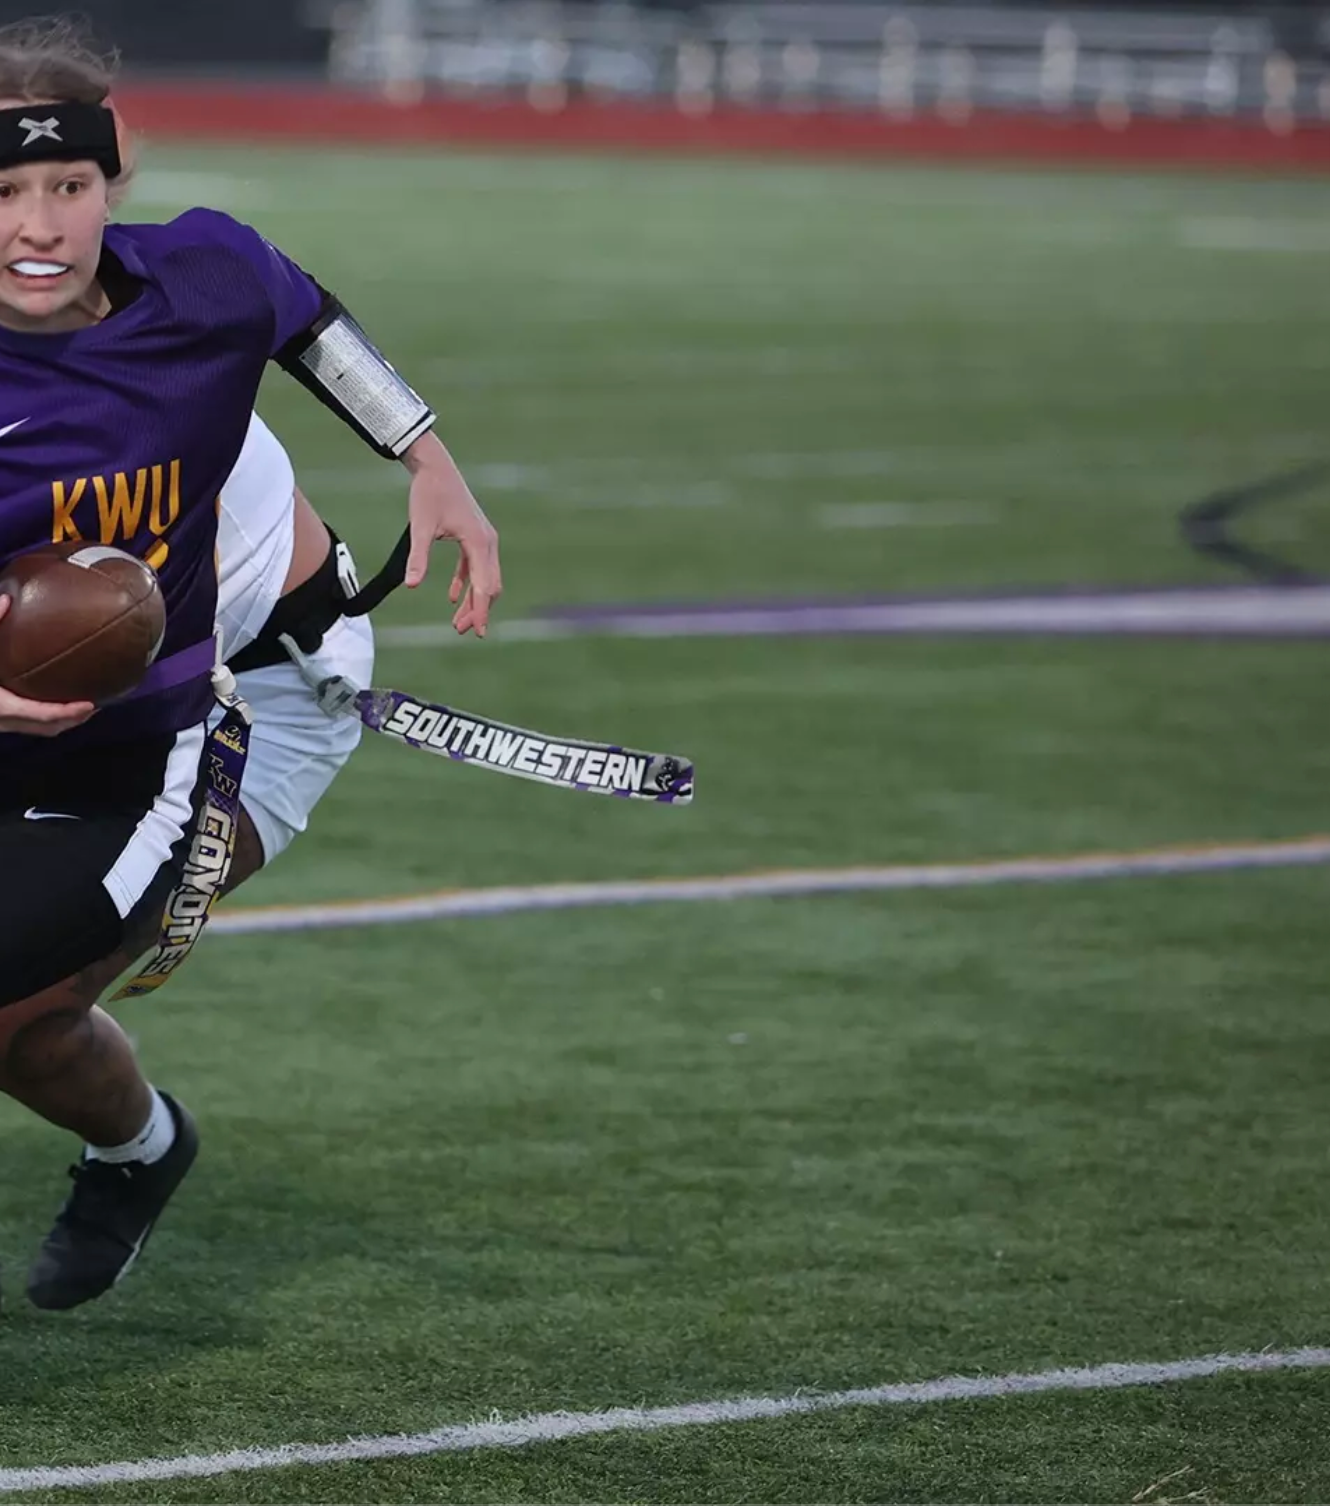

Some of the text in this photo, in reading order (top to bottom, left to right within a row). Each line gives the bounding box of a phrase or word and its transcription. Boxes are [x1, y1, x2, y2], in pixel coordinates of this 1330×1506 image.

[51, 459, 182, 545] KWU
[384, 701, 647, 792] SOUTHWESTERN
[139, 804, 232, 978] COYOTES
